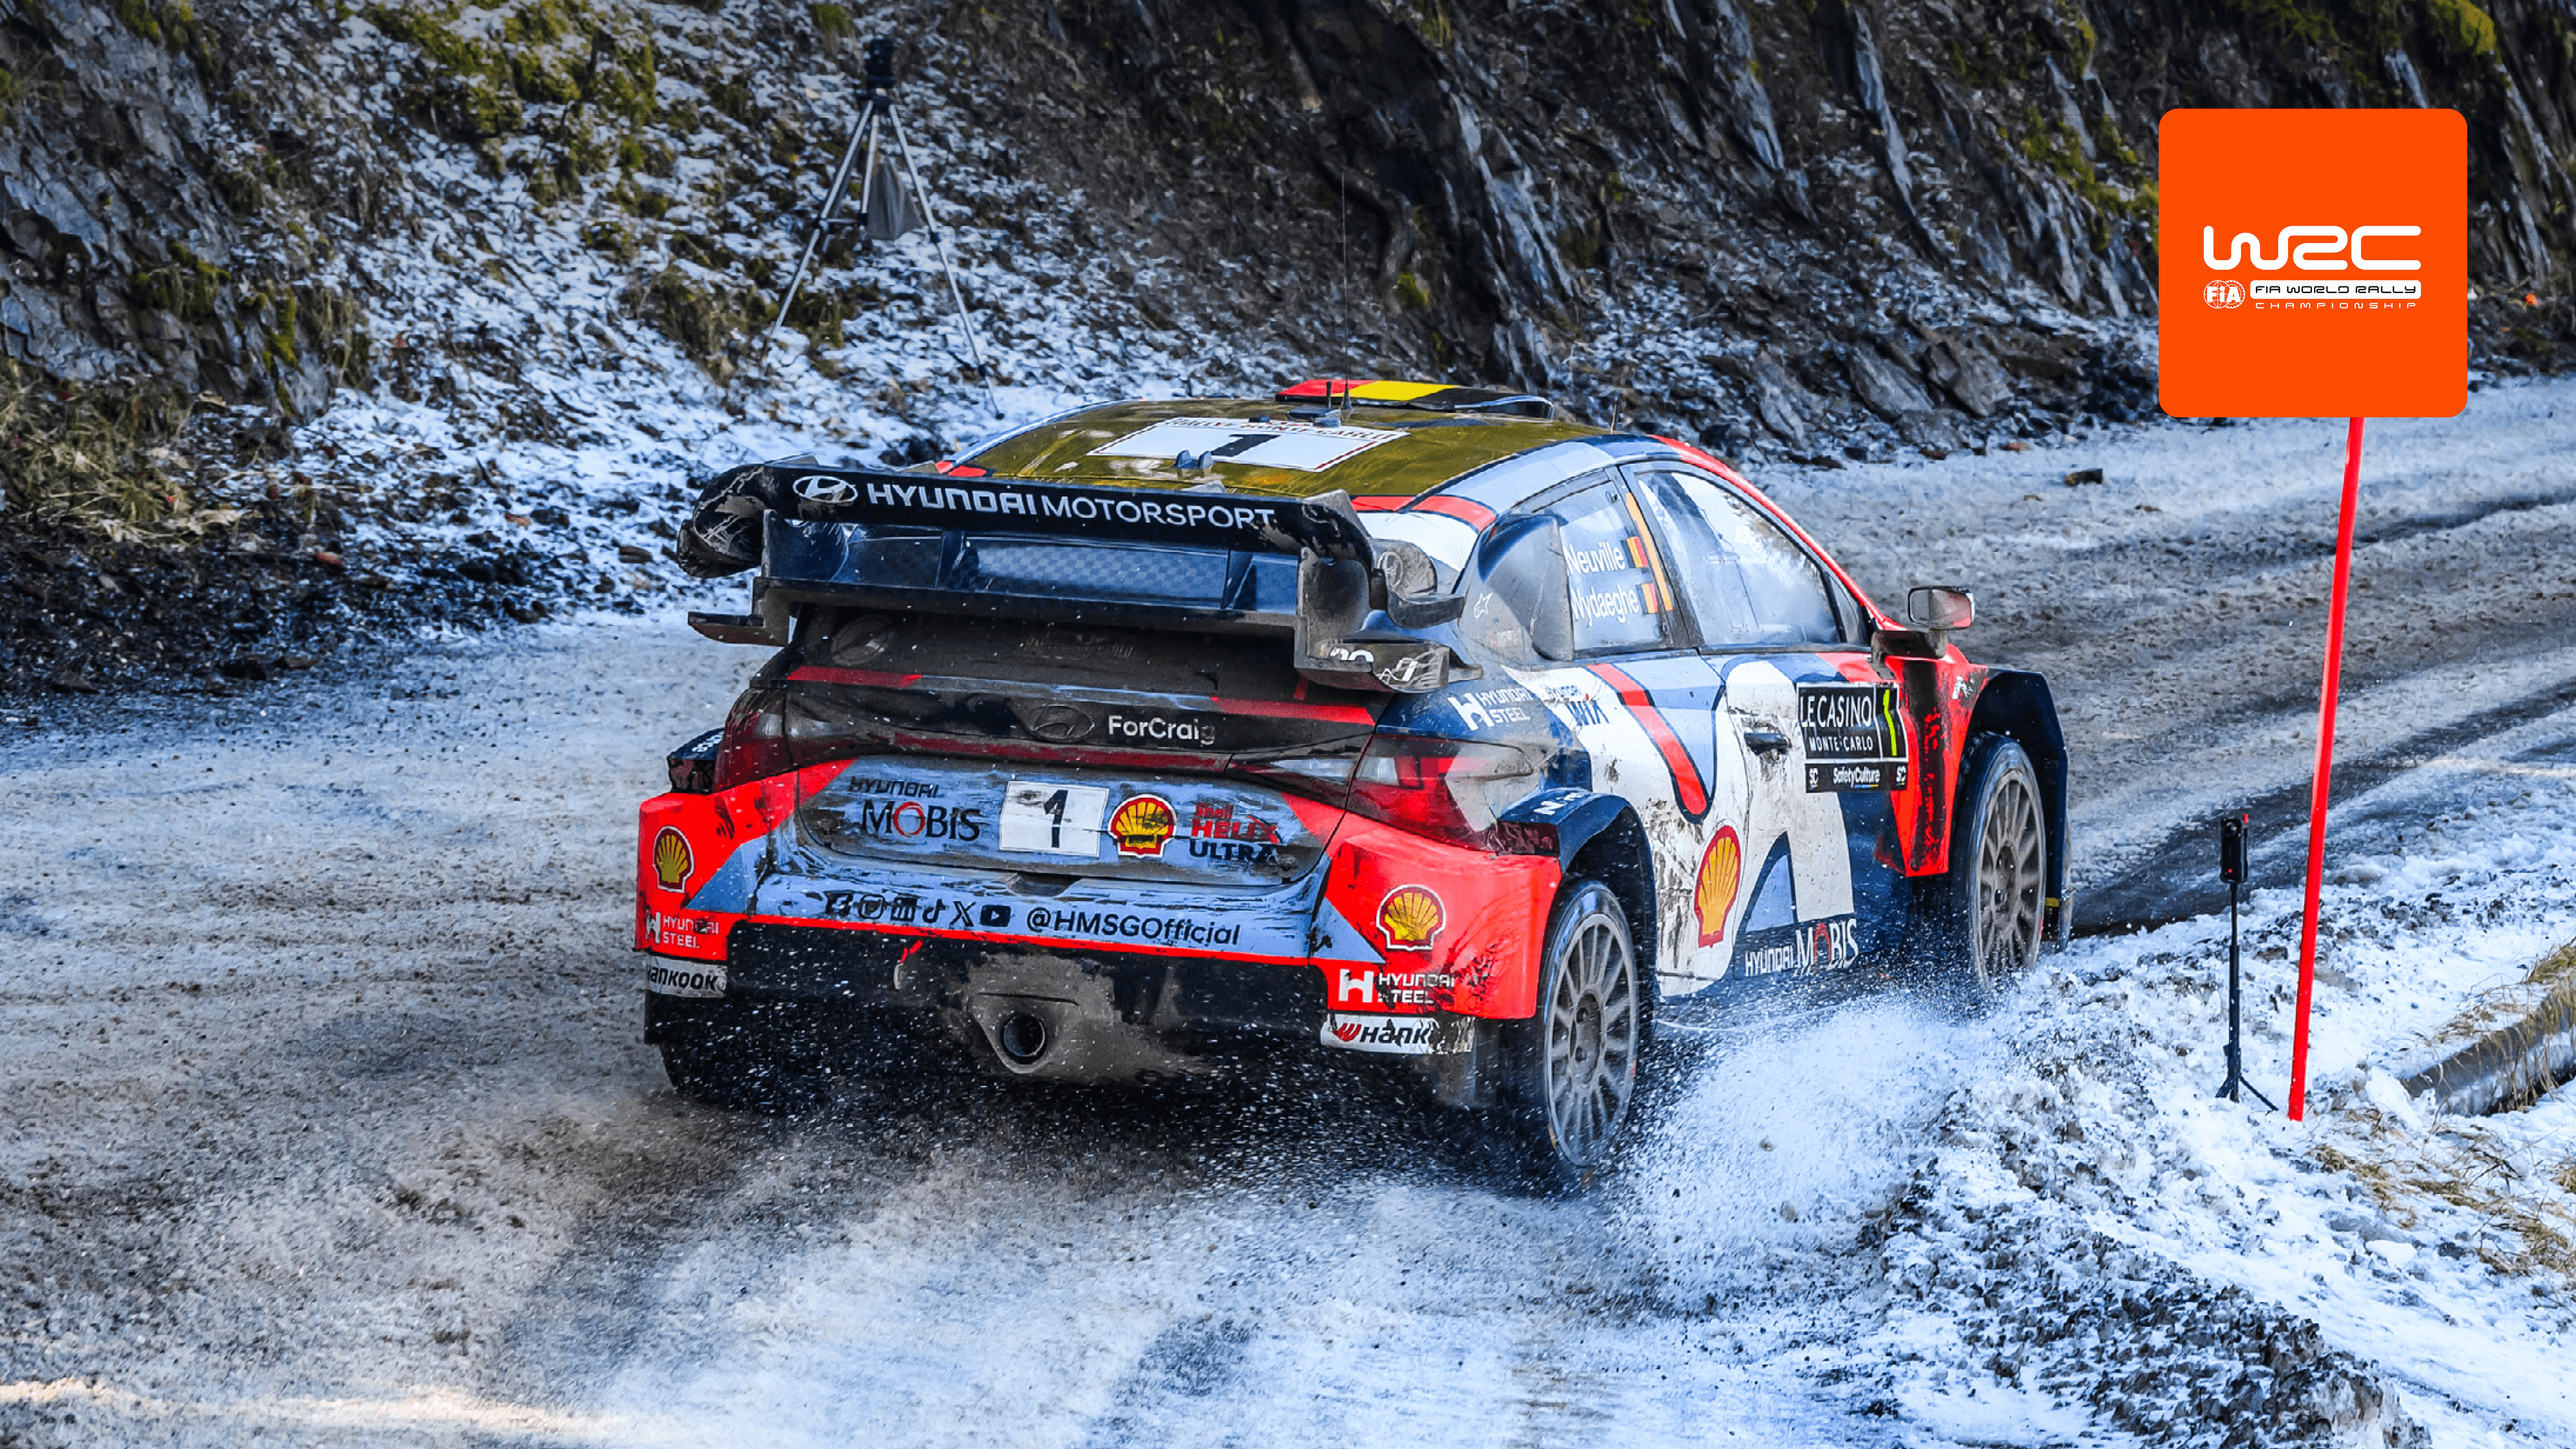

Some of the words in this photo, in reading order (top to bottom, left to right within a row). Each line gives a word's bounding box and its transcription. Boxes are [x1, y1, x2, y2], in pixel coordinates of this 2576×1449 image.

[1211, 433, 1281, 457] 1
[867, 482, 1036, 515] HYUNDAI
[1040, 495, 1274, 529] MOTORSPORT
[1564, 541, 1626, 575] Neuville
[1476, 688, 1534, 707] HYUNDAI
[1490, 706, 1531, 723] STEEL
[1108, 715, 1216, 745] ForCraig
[848, 775, 939, 799] HYUNDAI
[1833, 765, 1880, 789] SafetyCulture
[860, 799, 981, 842] MOBIS
[1043, 789, 1069, 848] 1
[1191, 814, 1283, 844] HELIX
[1190, 840, 1278, 863] ULTRA
[663, 931, 701, 949] STEEL
[1027, 906, 1240, 945] @HMSGOfficial
[1745, 945, 1794, 977] HYUNDAI
[1794, 918, 1859, 974] MOBIS
